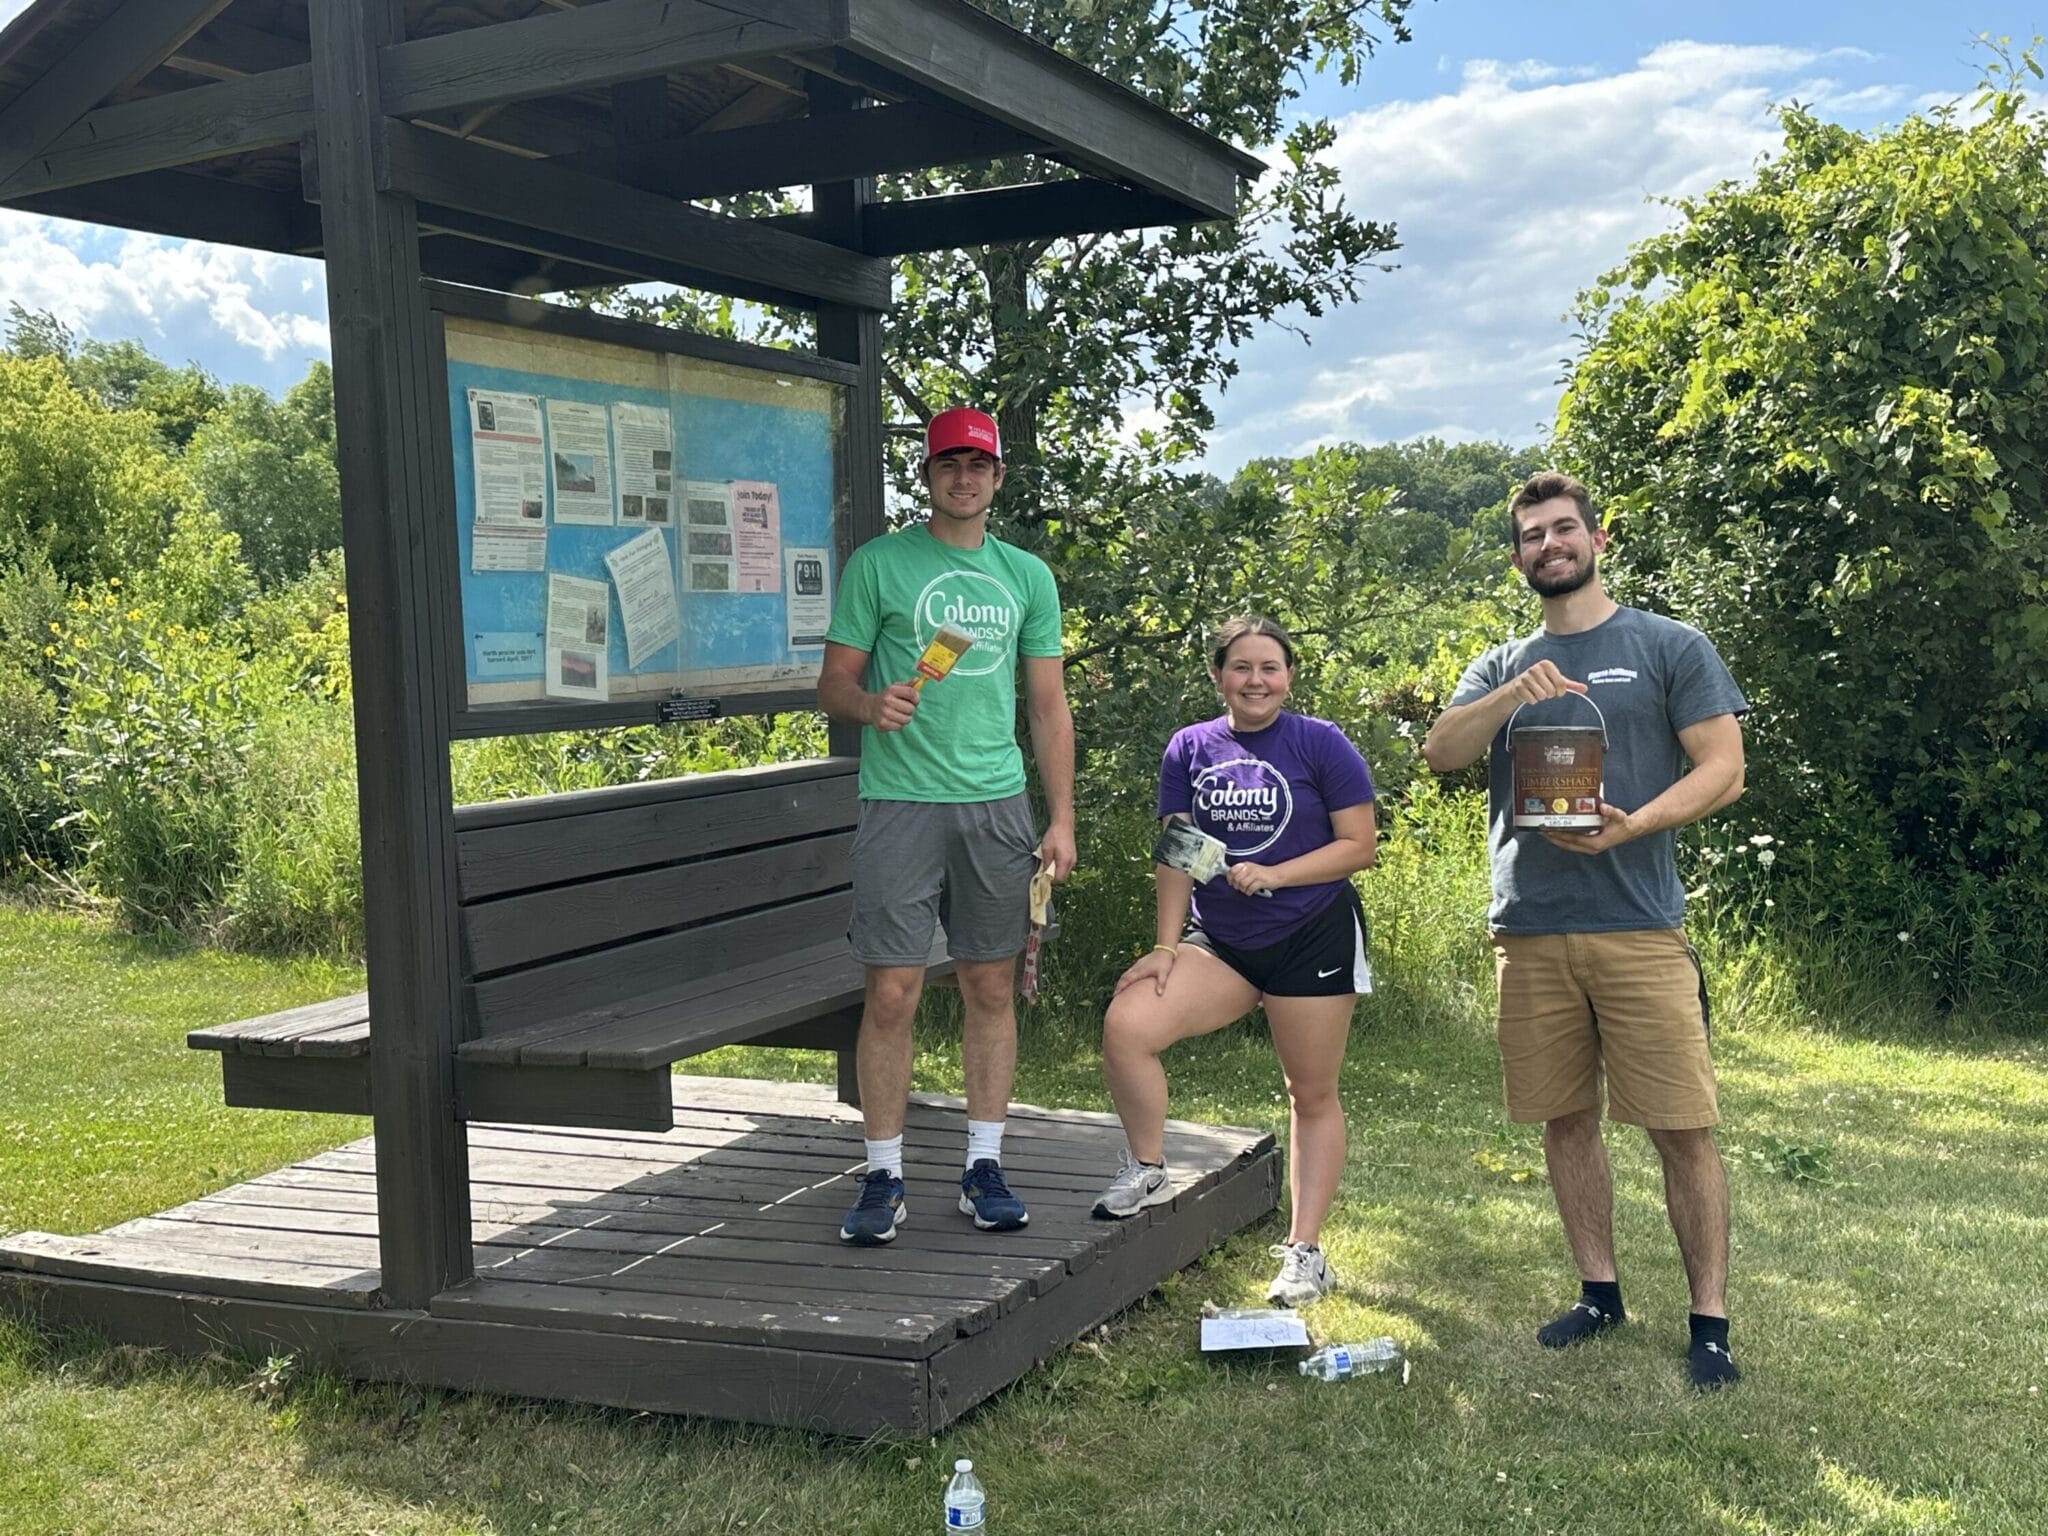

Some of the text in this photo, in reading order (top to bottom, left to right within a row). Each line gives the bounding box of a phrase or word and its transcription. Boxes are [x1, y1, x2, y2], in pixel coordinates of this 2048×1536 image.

[925, 591, 1009, 636] Colony
[1198, 776, 1277, 815] Colony
[1227, 822, 1274, 832] & Affiliates
